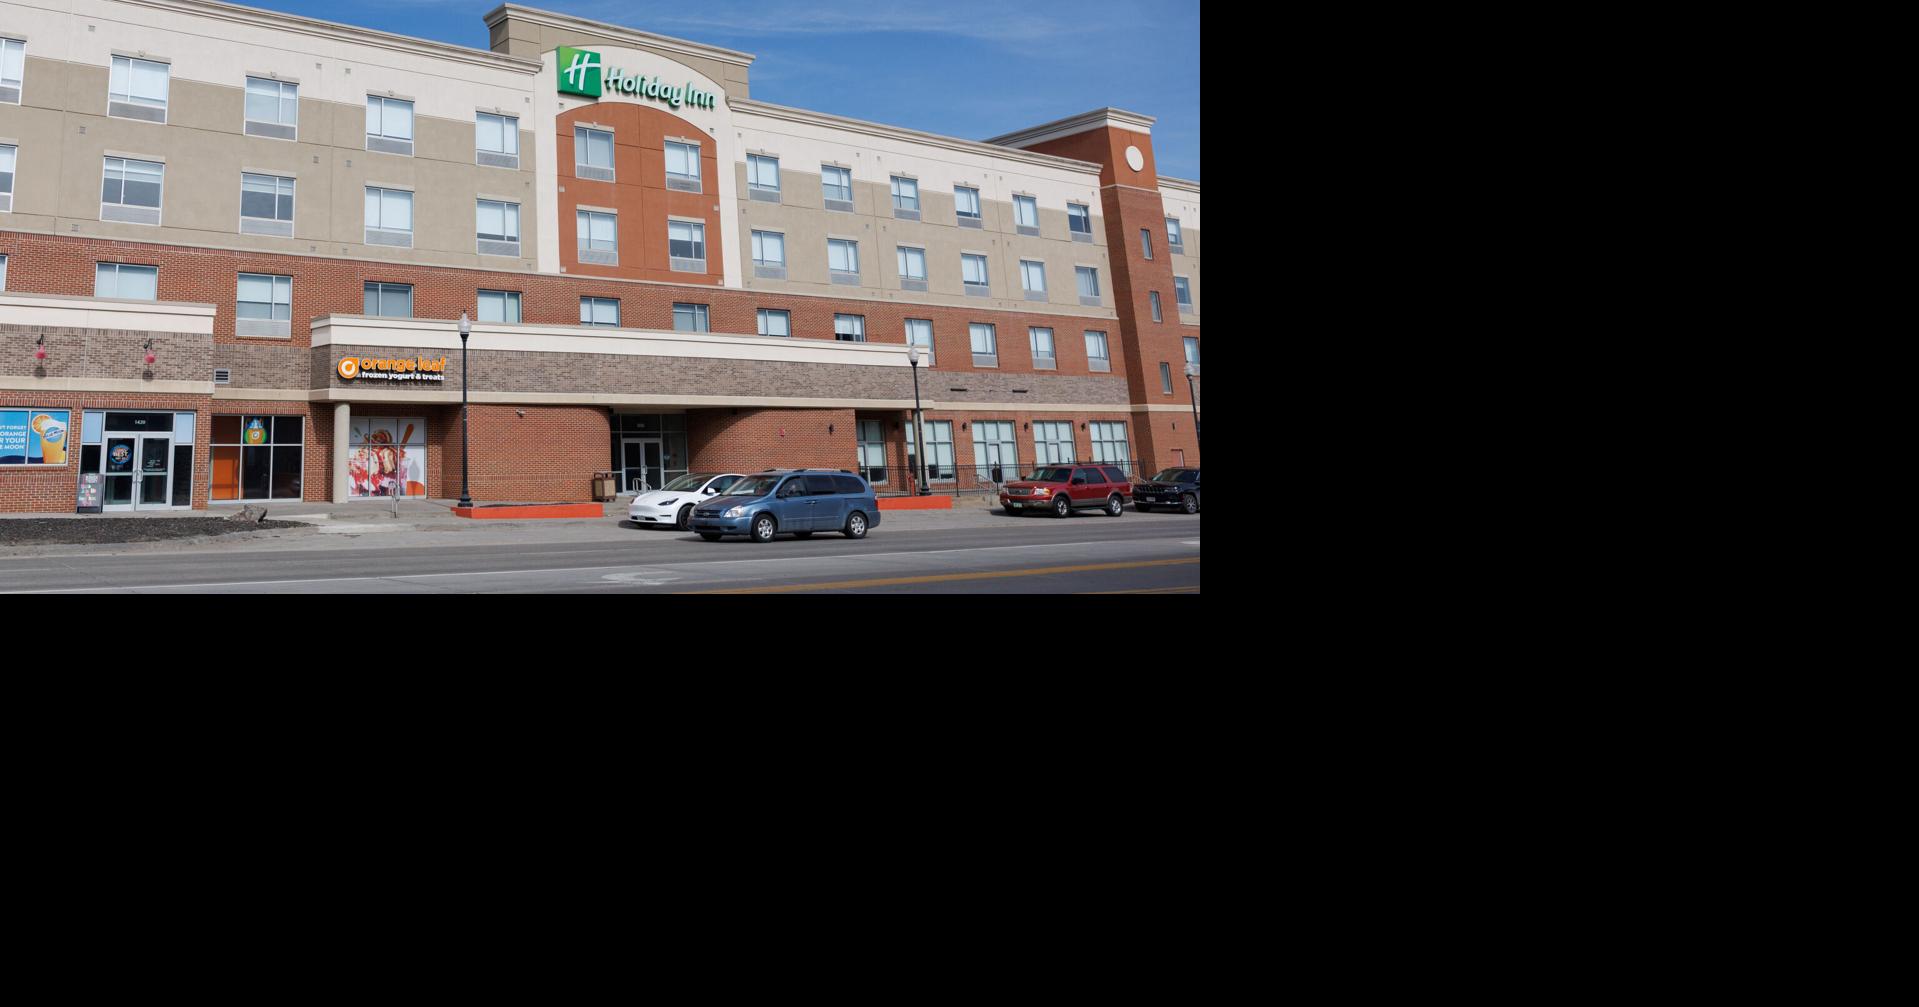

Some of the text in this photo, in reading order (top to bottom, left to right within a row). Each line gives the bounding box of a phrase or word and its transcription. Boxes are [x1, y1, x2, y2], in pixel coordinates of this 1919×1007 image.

[605, 67, 716, 108] Holiday Inn
[361, 355, 446, 373] orange leaf
[361, 371, 388, 379] frozen
[389, 373, 415, 381] yogurt
